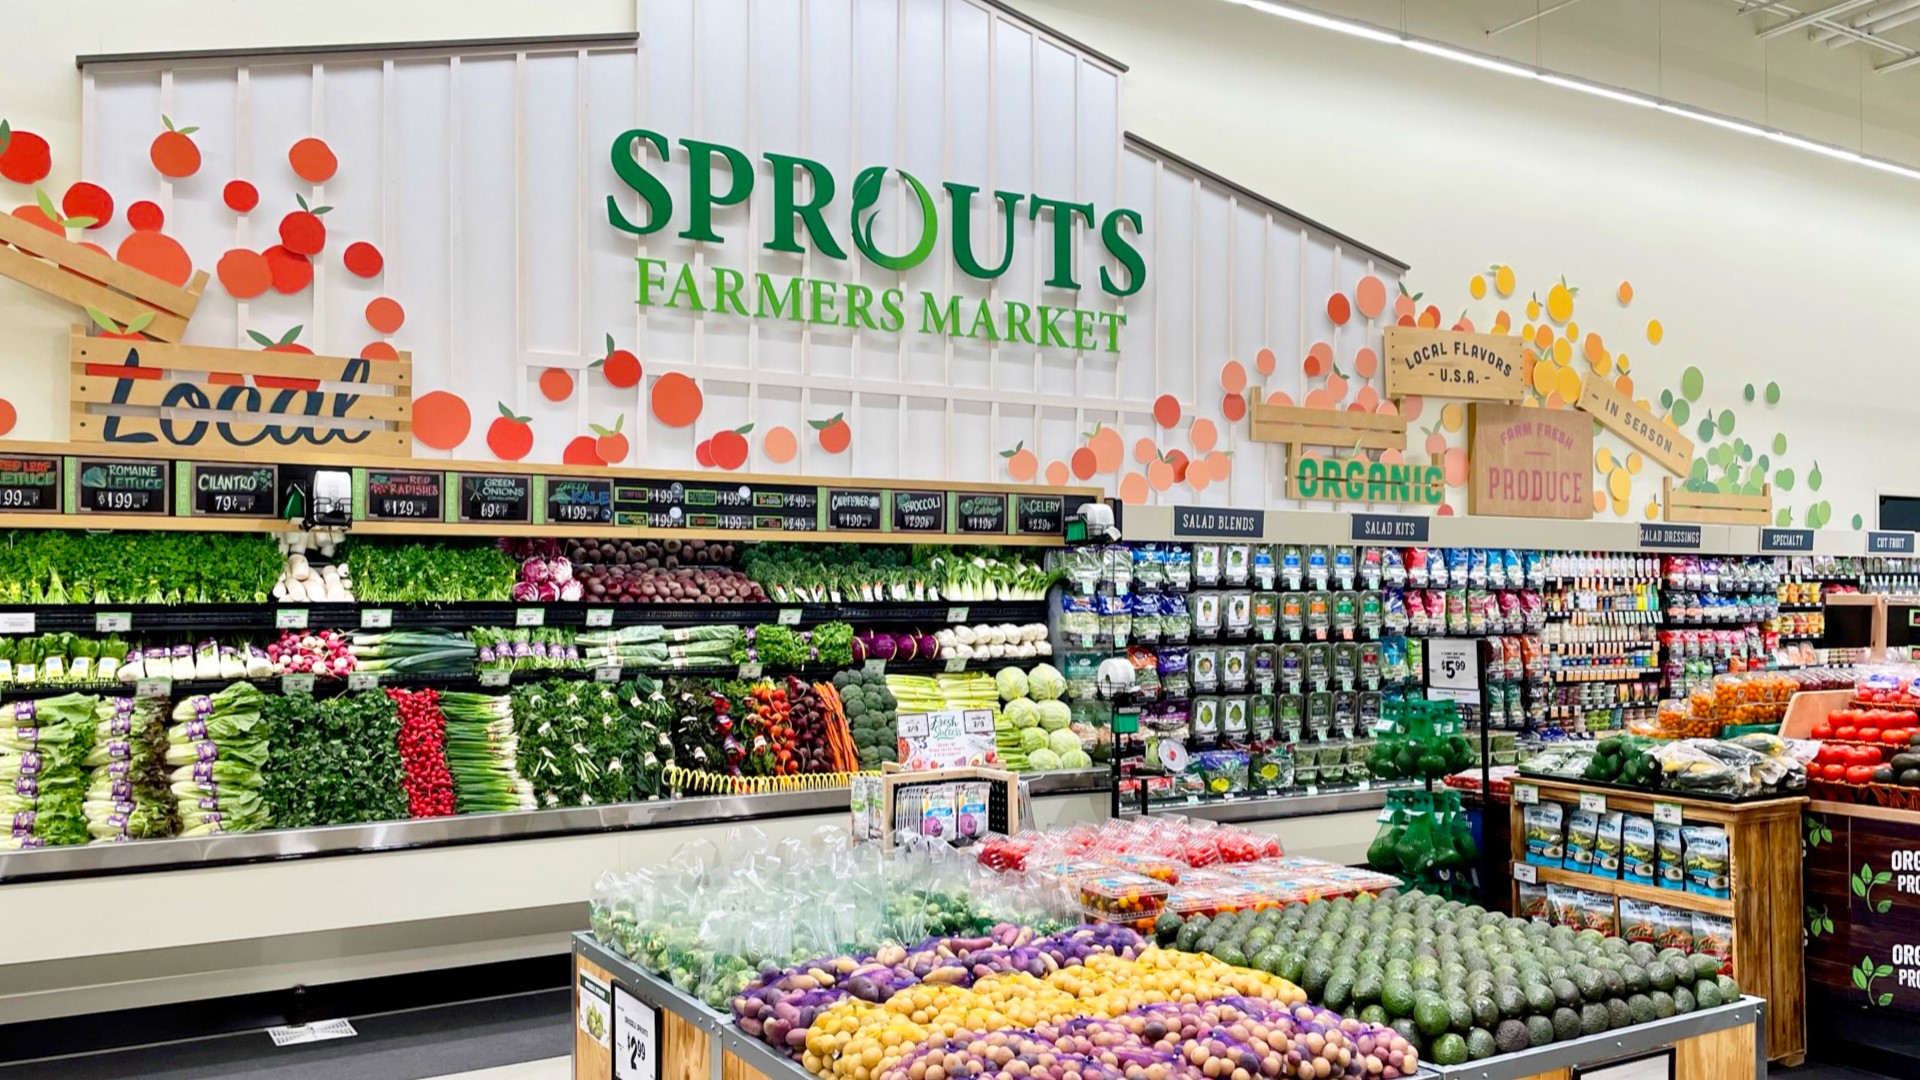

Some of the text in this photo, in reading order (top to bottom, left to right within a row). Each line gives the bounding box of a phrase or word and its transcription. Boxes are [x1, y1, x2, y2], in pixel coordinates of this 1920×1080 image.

[606, 128, 1147, 297] SPROUTS
[634, 257, 1127, 353] FARMERS MARKET
[1405, 341, 1512, 377] LOCAL FLAVORS
[103, 347, 374, 447] Local
[1605, 398, 1672, 453] IN SEASON
[1500, 422, 1573, 451] FARM FRESH
[107, 464, 158, 477] ROMAINE
[108, 476, 163, 490] LETTUCE
[198, 473, 257, 492] CILANTRO
[409, 475, 430, 485] RED
[484, 478, 516, 487] GREEN
[1299, 458, 1443, 504] ORGANIC
[1488, 466, 1582, 504] PRODUCE
[482, 486, 525, 498] ONIONS
[571, 490, 611, 506] KALE
[215, 495, 238, 512] 79¢
[481, 502, 501, 518] 69¢
[902, 496, 941, 513] BROCCOLI
[1030, 499, 1060, 513] CELERY
[1182, 513, 1254, 532] SALAD BLENDS
[1365, 521, 1415, 536] SALAD KITS
[1640, 529, 1700, 544] SALAD DRESSINGS
[1772, 534, 1804, 547] SPECIALTY
[1876, 537, 1905, 549] CUT FRUIT
[930, 714, 959, 731] Fresh
[934, 726, 962, 740] Success
